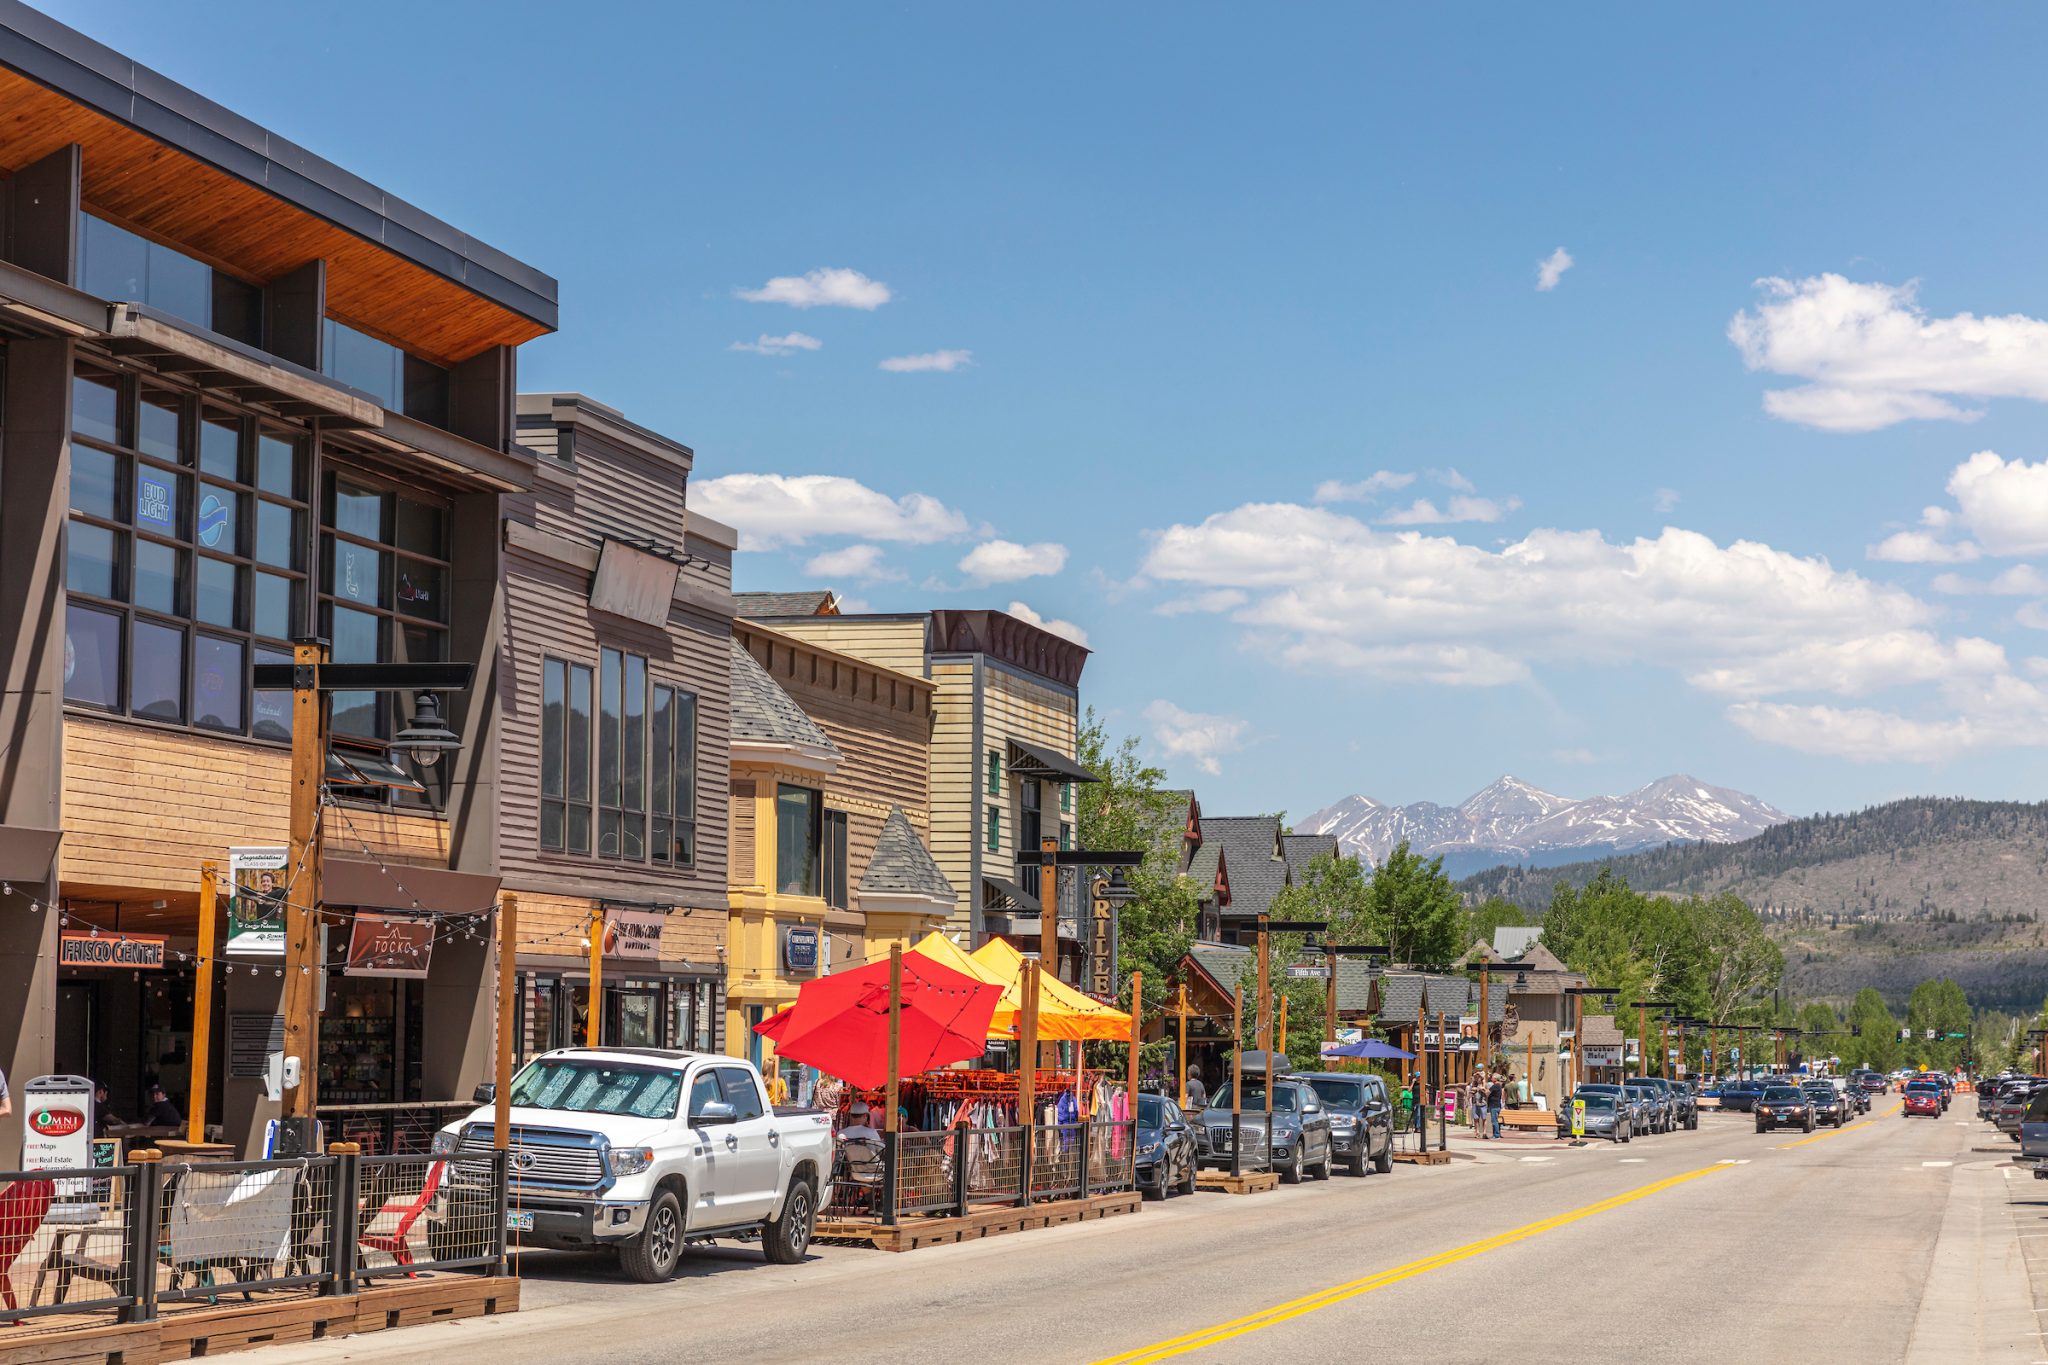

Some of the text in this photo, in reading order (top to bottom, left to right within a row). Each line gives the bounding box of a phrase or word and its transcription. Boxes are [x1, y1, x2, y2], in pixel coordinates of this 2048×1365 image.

[144, 482, 165, 503] BUD
[139, 498, 169, 522] LIGHT
[239, 853, 285, 861] Congratulations!
[1093, 879, 1111, 995] GRILLE
[63, 939, 163, 964] FRISCO CENTRE
[38, 1112, 78, 1126] OMNI
[40, 1143, 56, 1151] Maps
